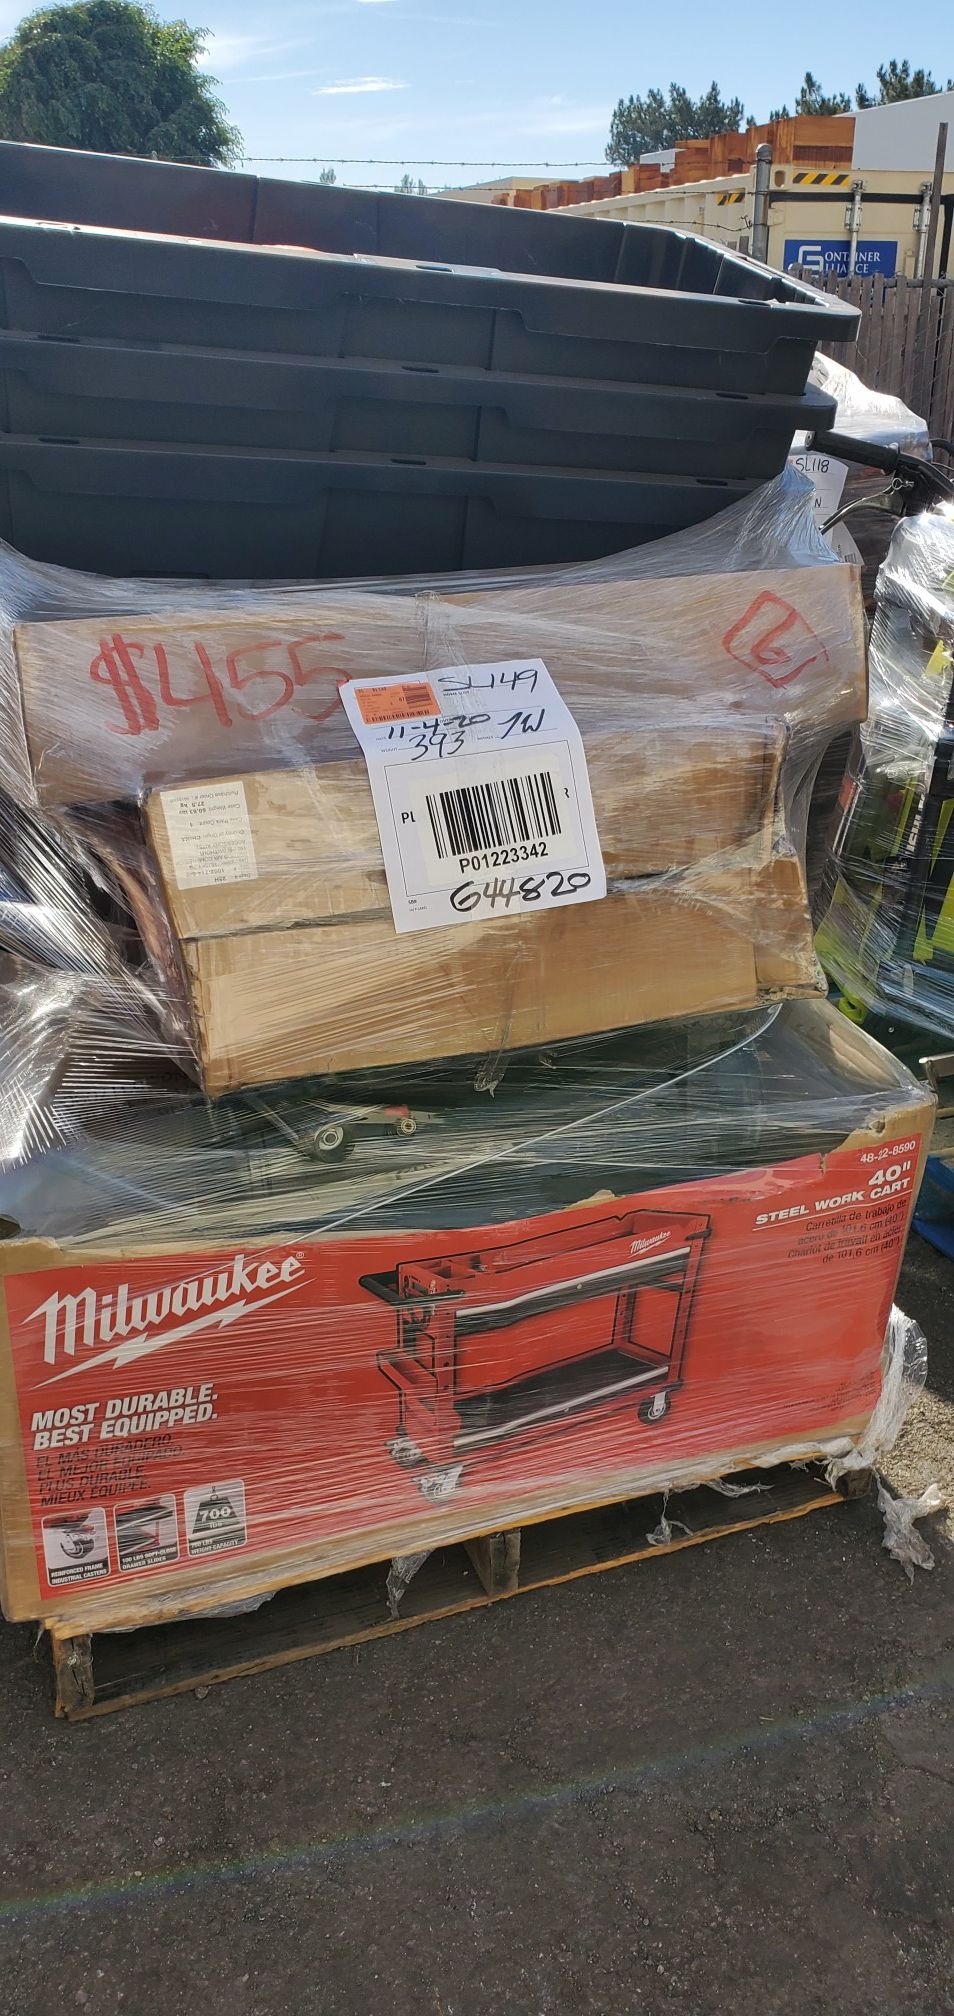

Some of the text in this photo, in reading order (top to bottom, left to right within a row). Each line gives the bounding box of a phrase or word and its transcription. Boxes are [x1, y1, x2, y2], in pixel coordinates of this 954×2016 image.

[796, 458, 829, 473] SL118
[90, 633, 351, 735] $455
[438, 669, 538, 693] SL149
[388, 713, 491, 739] 11-4-20
[408, 730, 467, 761] 393
[459, 841, 549, 874] P01223342
[450, 872, 591, 912] 644820
[868, 1161, 911, 1186] 40"
[756, 1177, 911, 1225] STEEL WORK CART
[849, 1211, 862, 1221] de
[865, 1204, 895, 1220] trabajo
[896, 1199, 907, 1208] de
[822, 1252, 836, 1263] de
[865, 1245, 879, 1256] cm
[31, 1384, 218, 1431] MOST DURABLE.
[34, 1403, 218, 1450] BEST EQUIPPED.
[36, 1456, 52, 1468] EL
[41, 1490, 85, 1506] MIEUX
[200, 1507, 231, 1523] 700
[83, 1568, 108, 1580] CASTERS
[84, 1562, 104, 1572] FRAME
